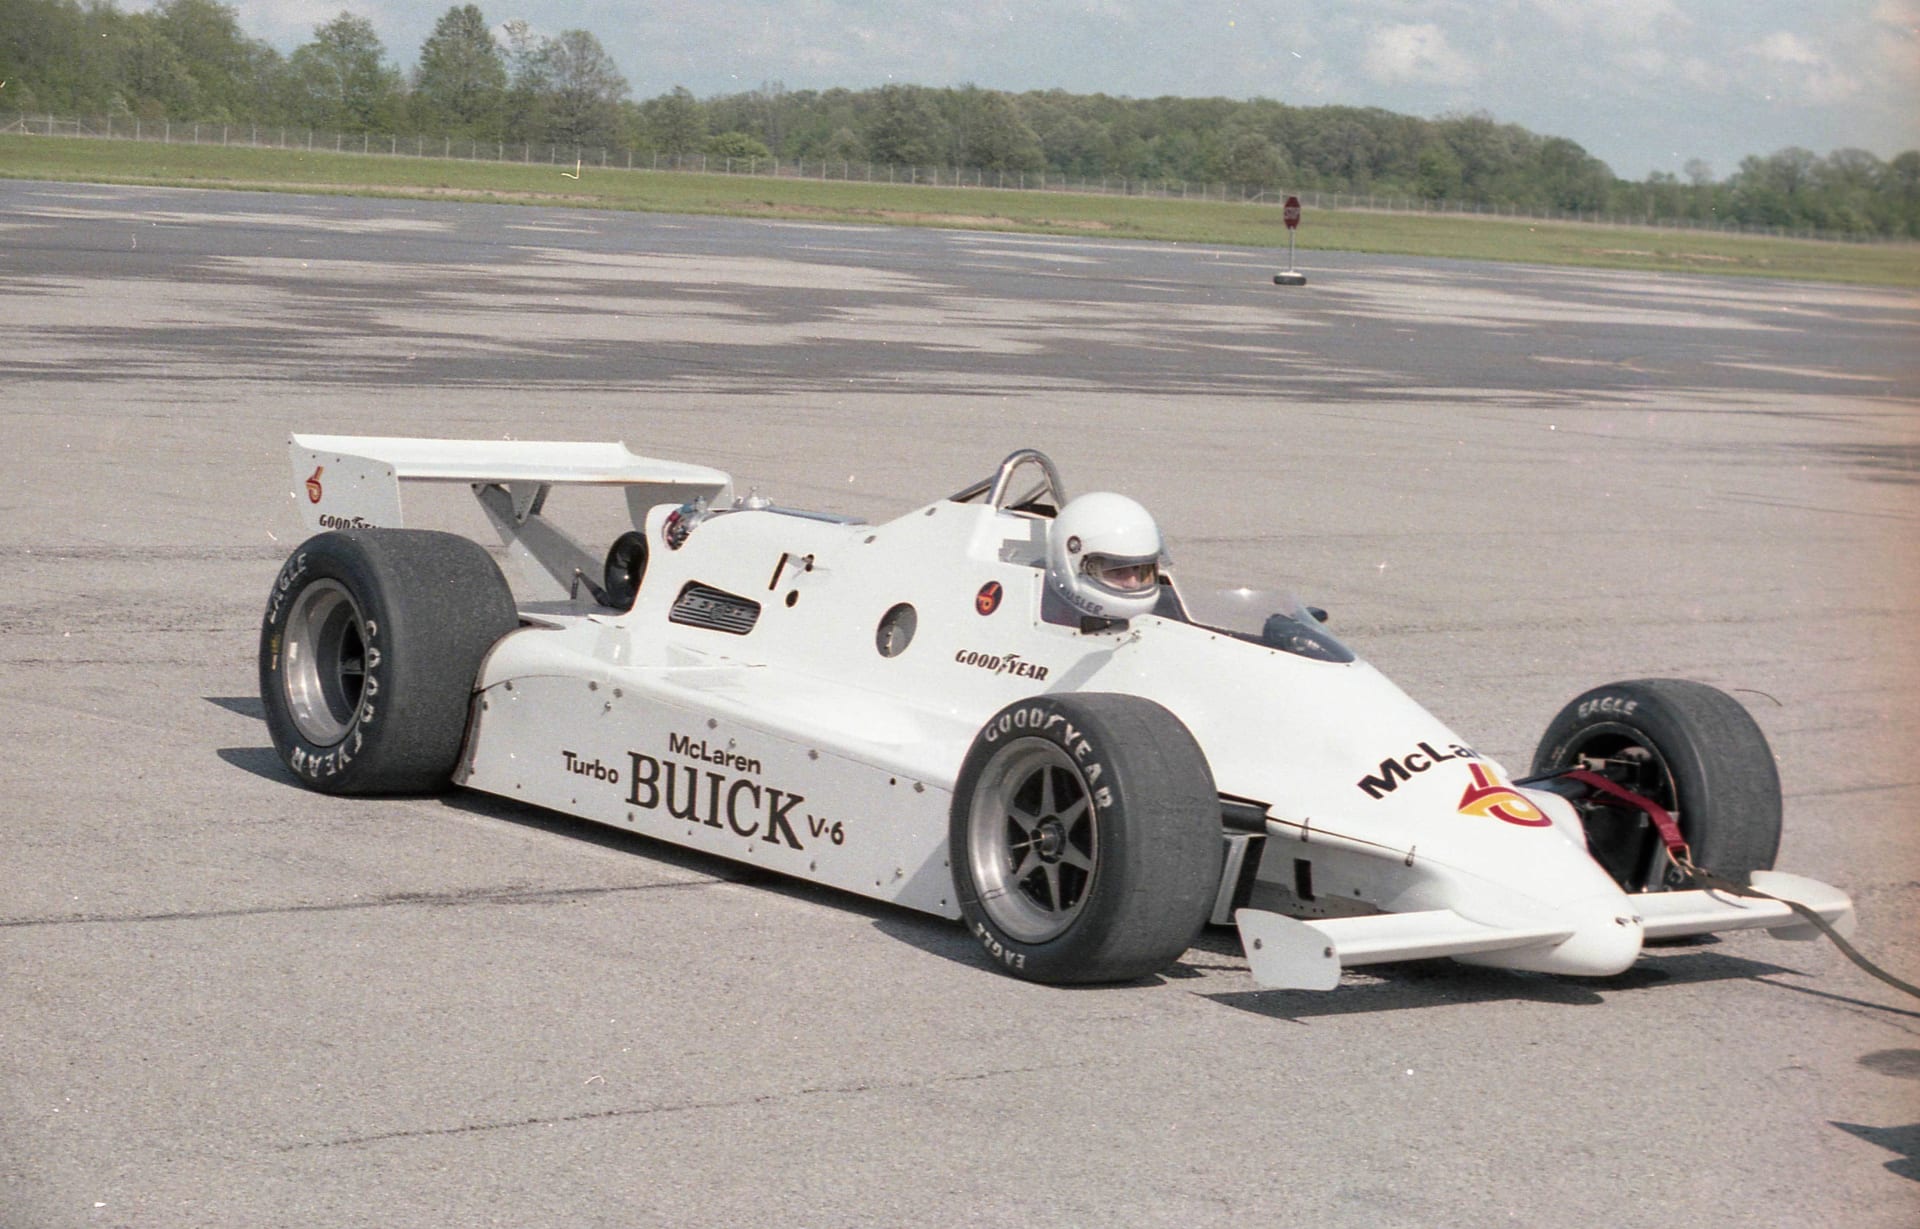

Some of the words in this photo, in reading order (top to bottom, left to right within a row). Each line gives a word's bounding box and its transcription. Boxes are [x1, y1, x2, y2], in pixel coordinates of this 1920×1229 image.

[319, 514, 377, 529] GOOD
[269, 553, 307, 624] EAGLE
[955, 649, 1049, 681] GOODYEAR
[292, 619, 381, 778] GOODYEAR
[1578, 697, 1638, 718] EAGLE
[669, 732, 761, 774] McLaren
[985, 708, 1113, 808] GOODYEAR
[1357, 742, 1481, 800] McLa
[562, 751, 619, 784] Turbo
[625, 751, 804, 851] BUICK
[975, 921, 1026, 969] EAGLE
